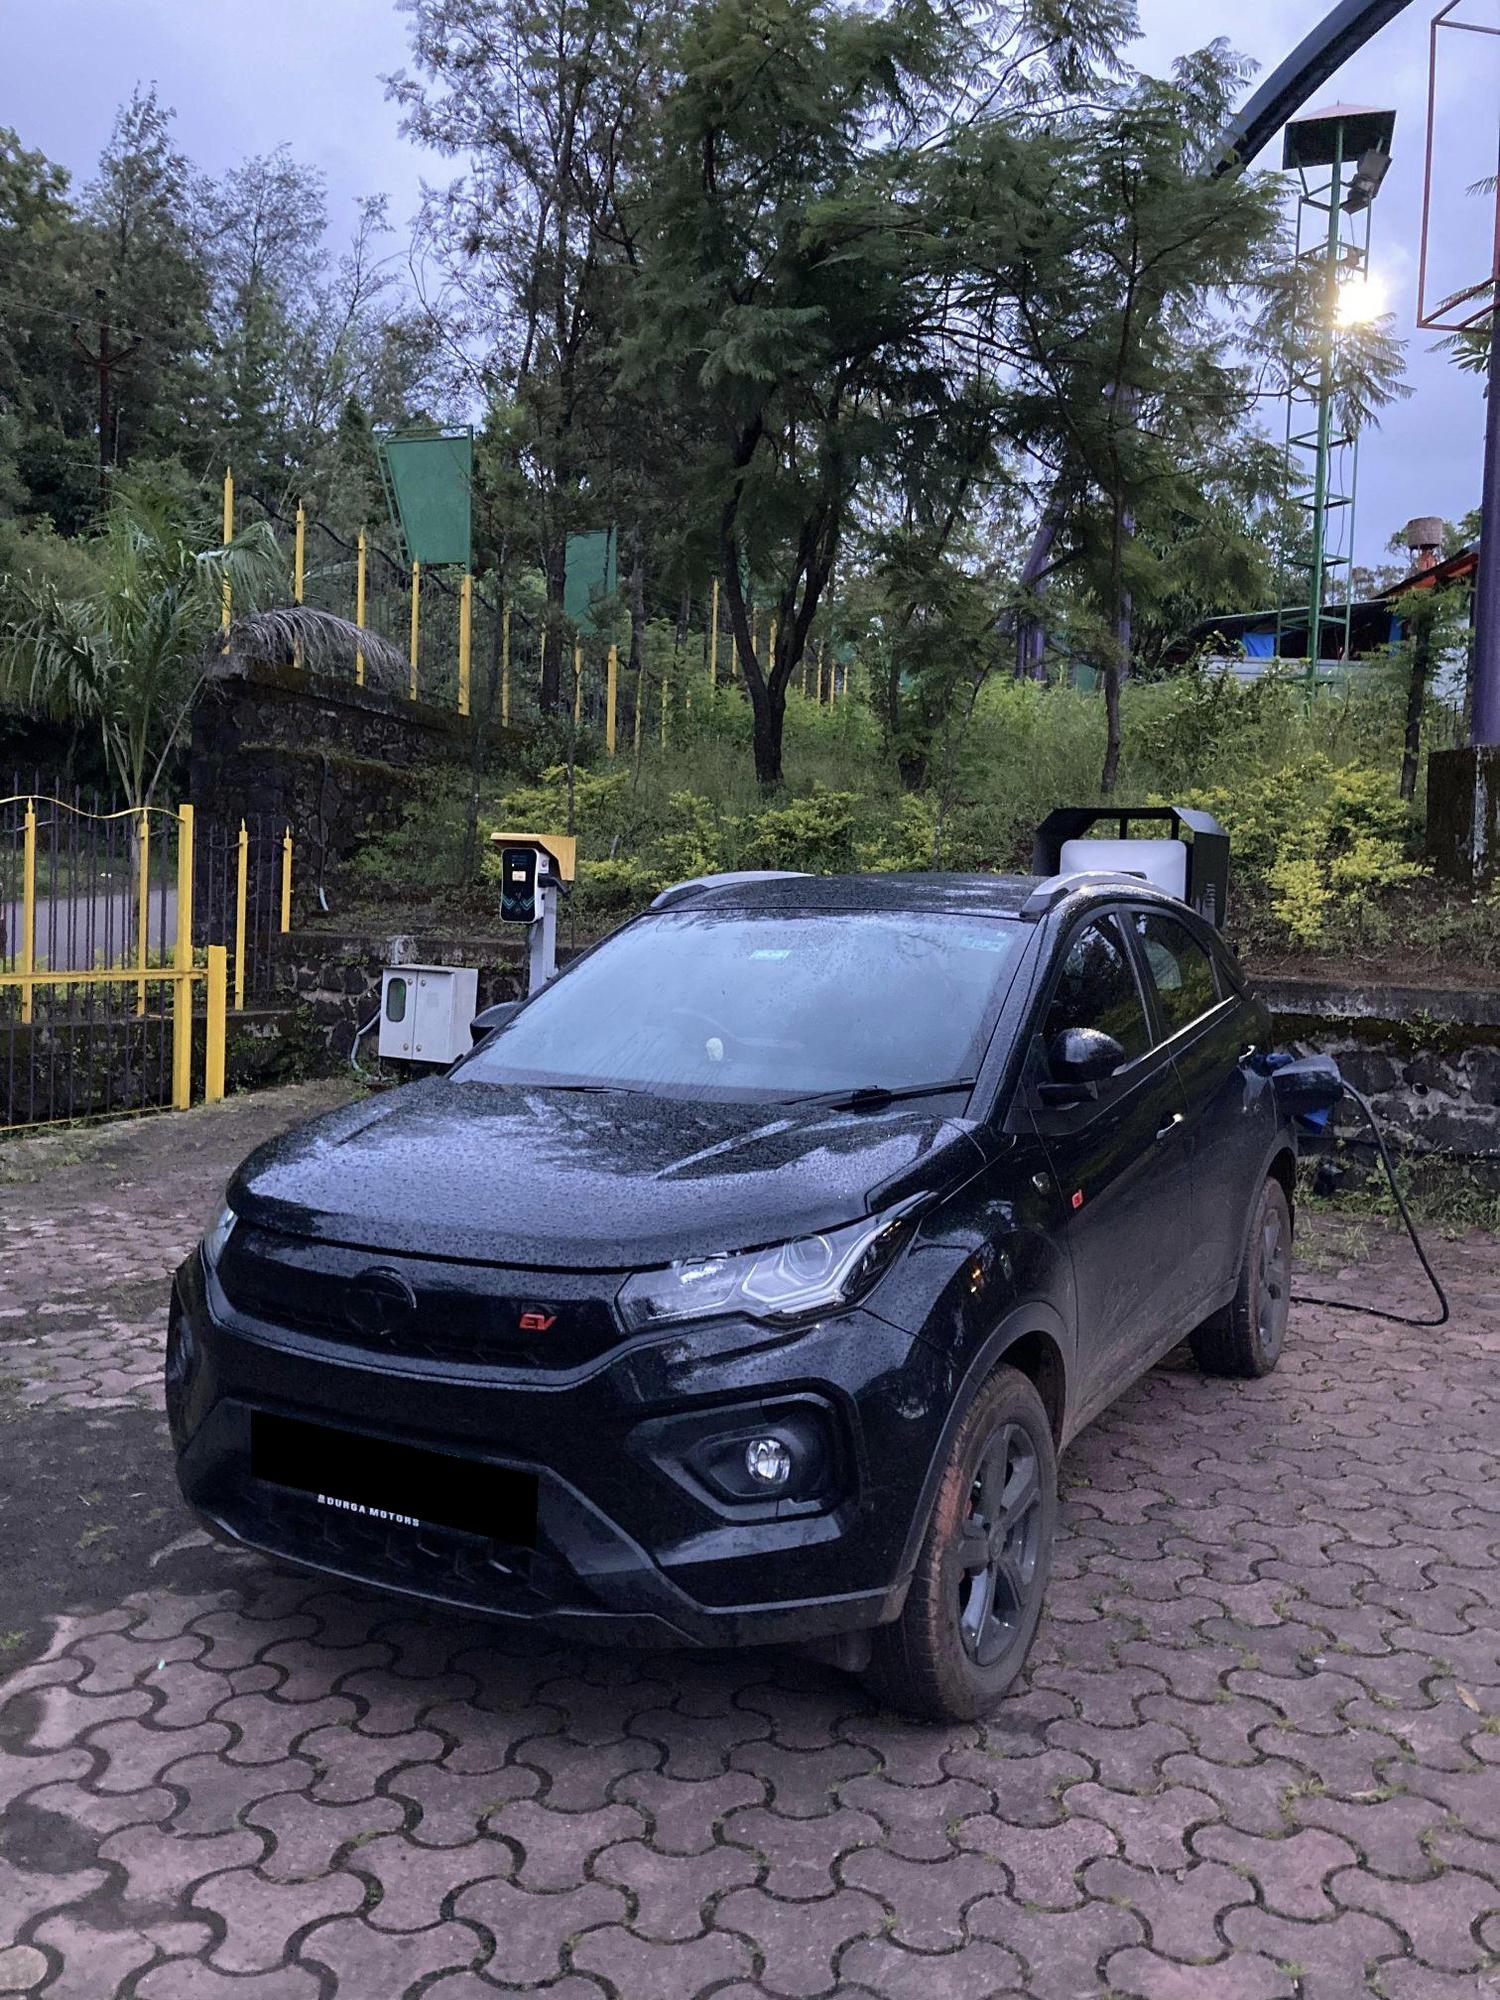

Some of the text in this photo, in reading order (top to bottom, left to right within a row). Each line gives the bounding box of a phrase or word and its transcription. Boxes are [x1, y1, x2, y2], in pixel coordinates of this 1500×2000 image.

[519, 1313, 557, 1330] EV
[326, 1496, 420, 1527] DURGA MOTORS
